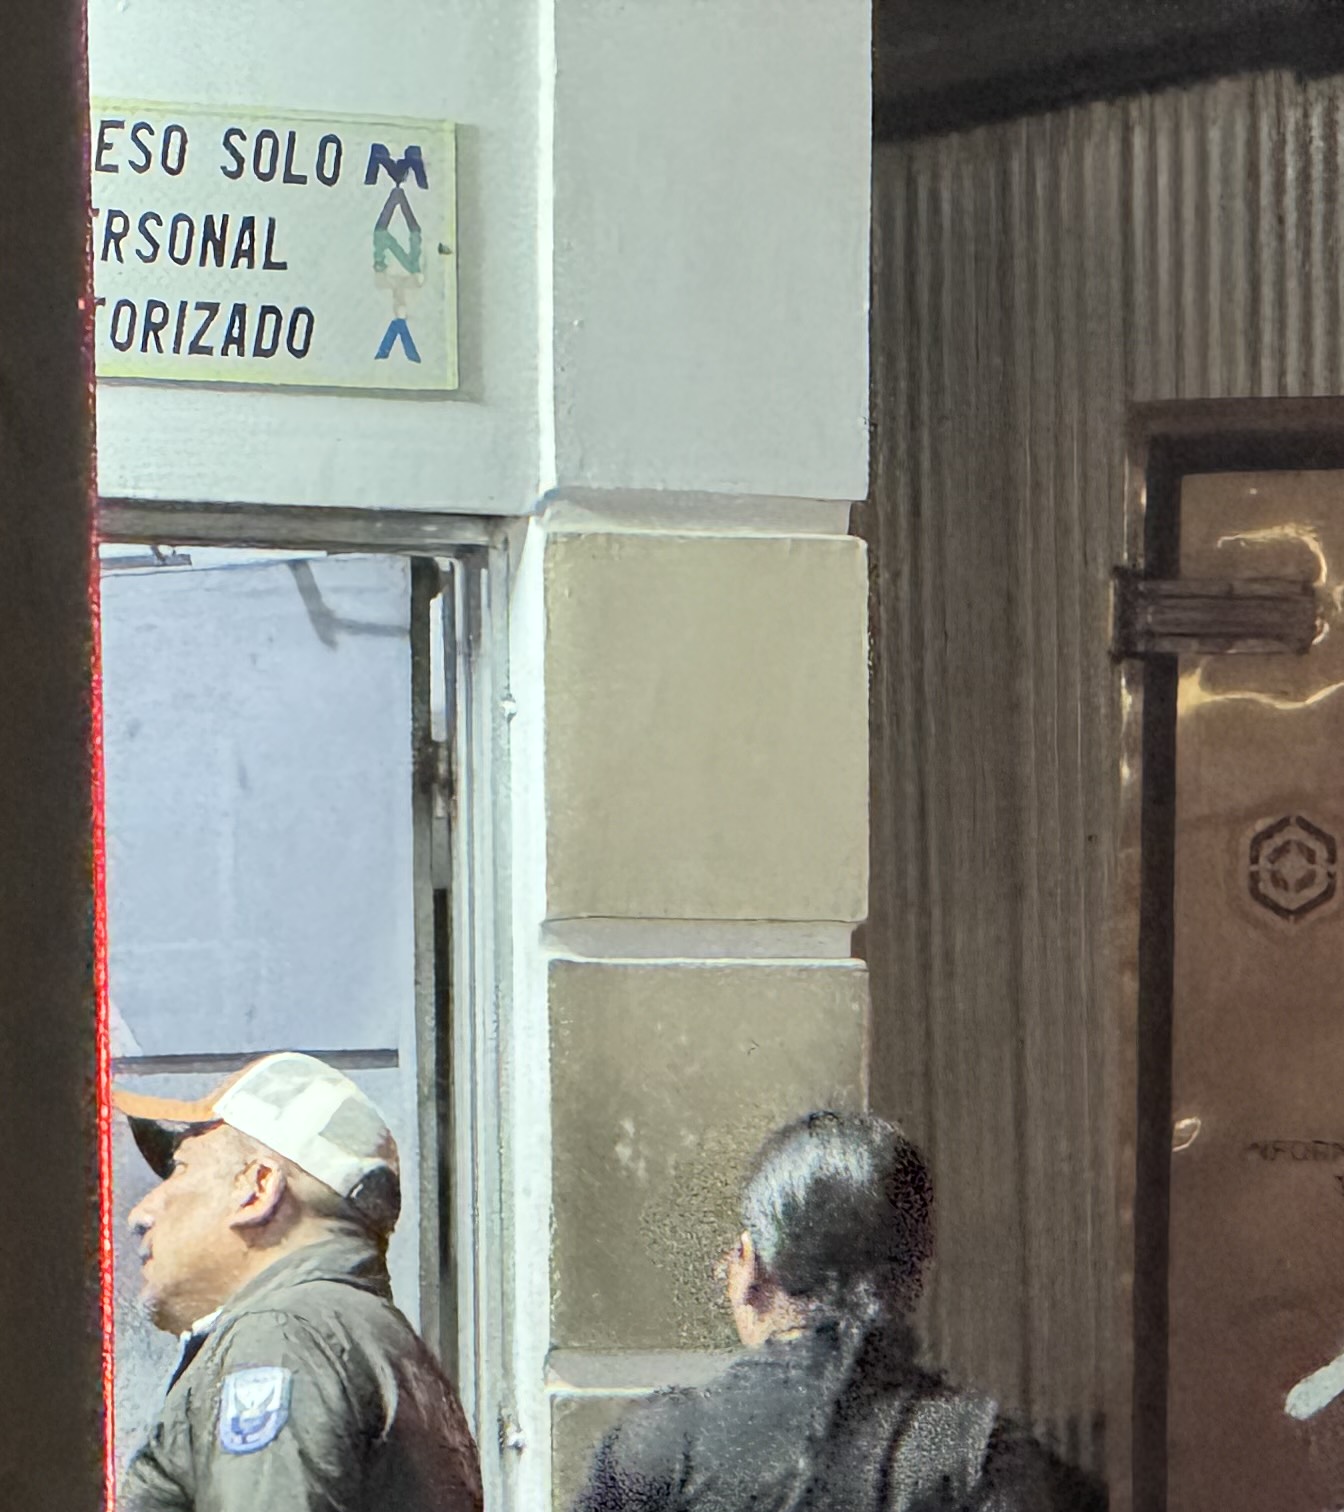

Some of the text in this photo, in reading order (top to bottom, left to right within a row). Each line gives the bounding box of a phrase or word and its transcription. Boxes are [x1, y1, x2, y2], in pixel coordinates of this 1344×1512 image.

[95, 119, 342, 187] ESO SOLO
[91, 207, 288, 270] RSONAL
